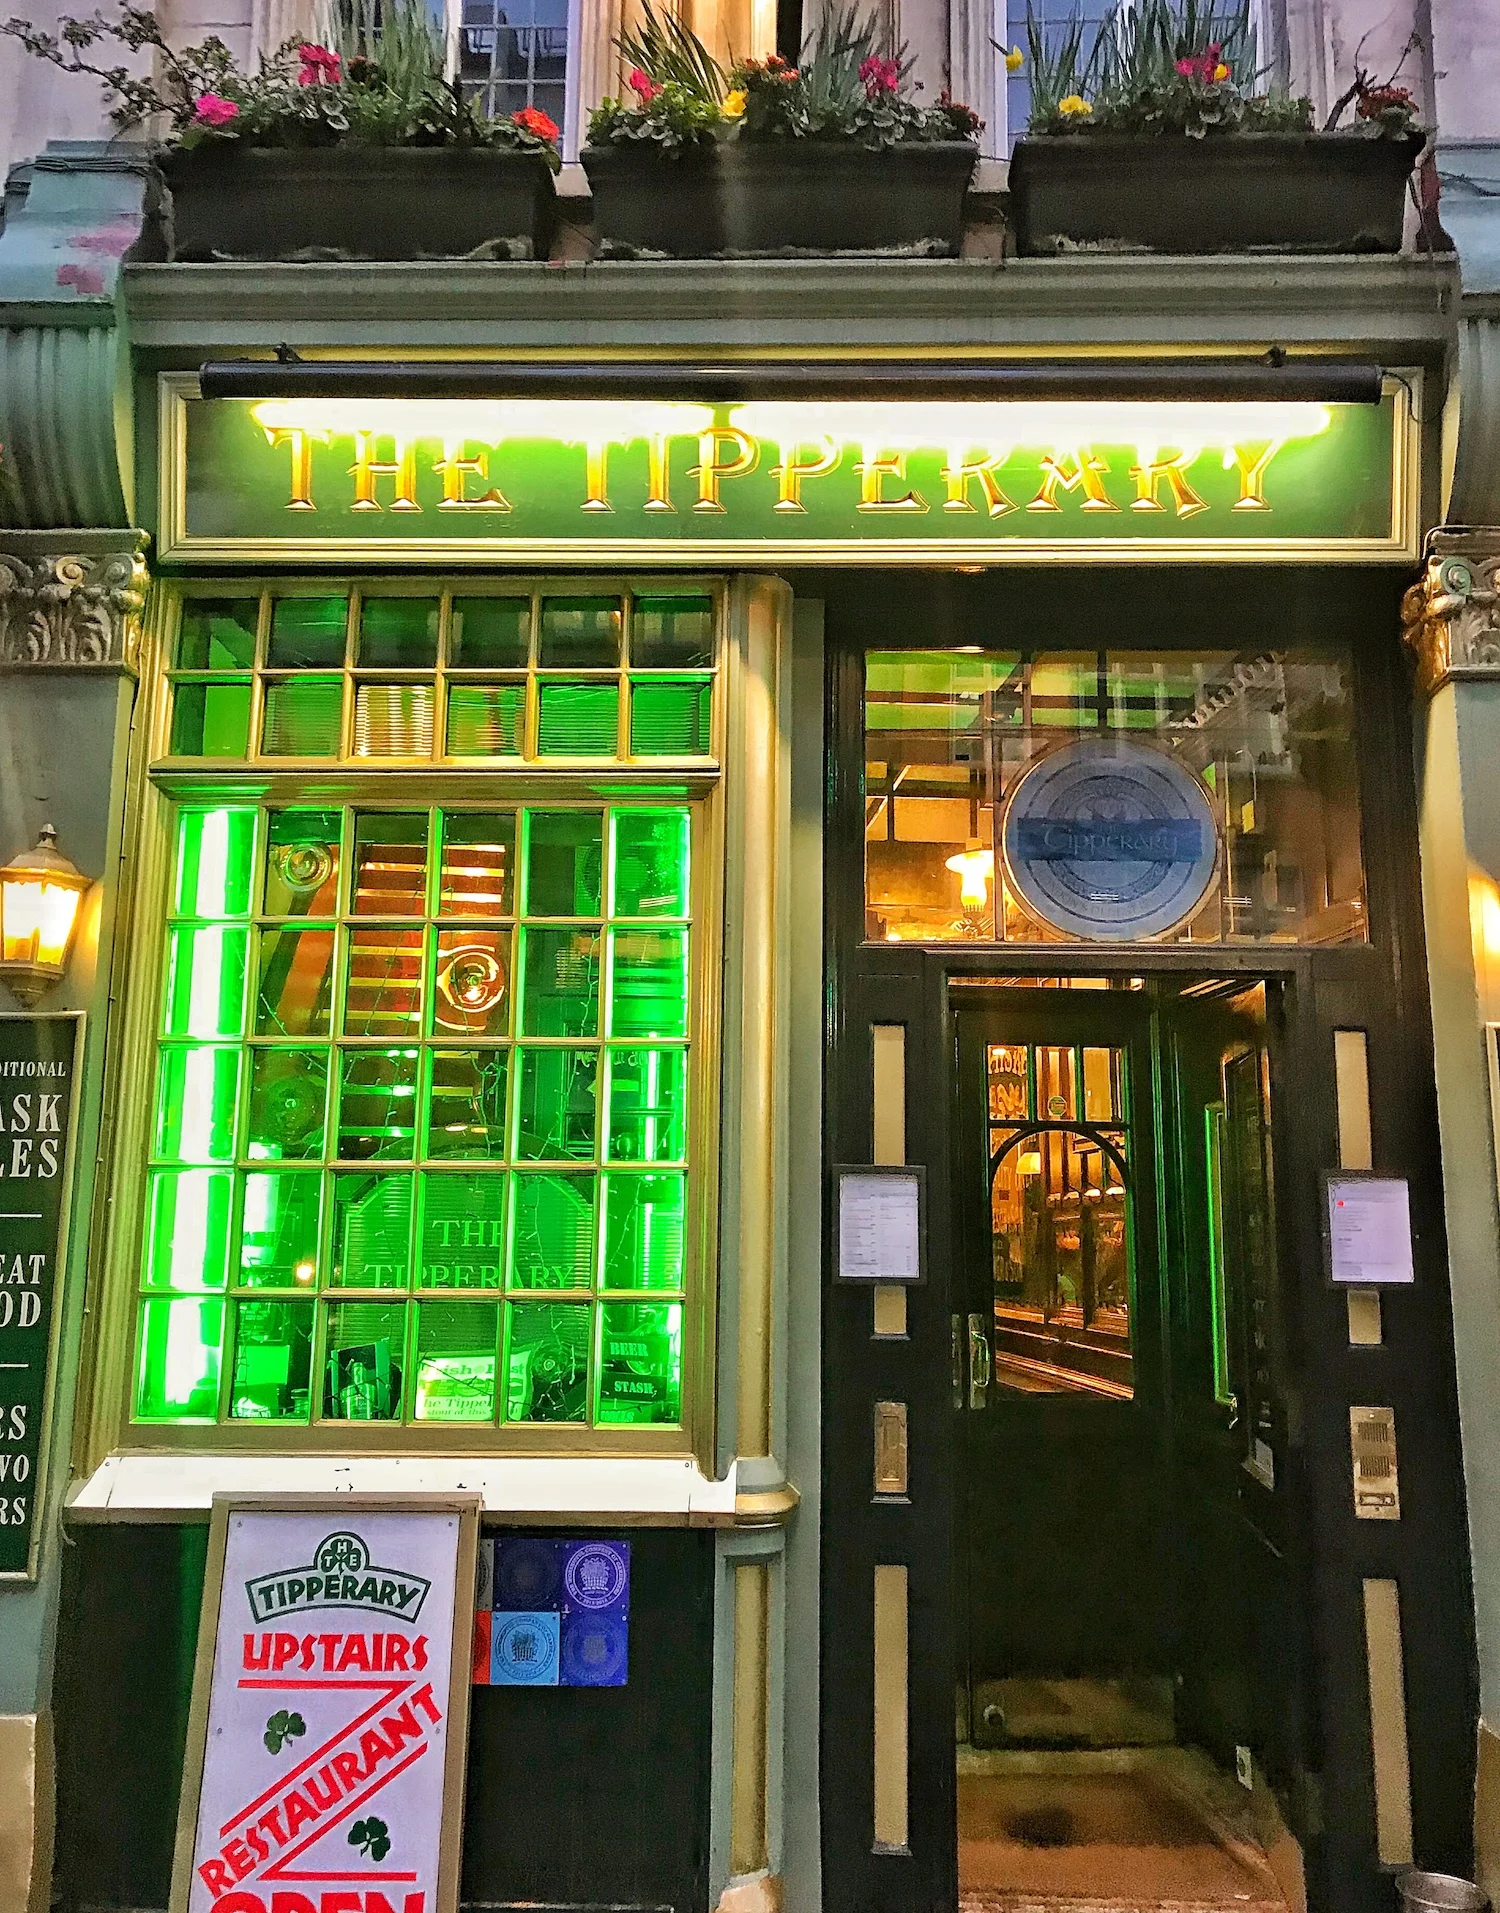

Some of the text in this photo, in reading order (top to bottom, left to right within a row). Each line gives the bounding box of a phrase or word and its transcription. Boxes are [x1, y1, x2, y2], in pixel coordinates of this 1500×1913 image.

[263, 427, 1288, 520] THE TIPPERARY
[0, 1061, 66, 1077] ITIONAL
[0, 1094, 62, 1133] SK
[0, 1138, 58, 1178] ES
[363, 1264, 574, 1289] TIPERRY
[609, 1342, 648, 1357] BEER
[614, 1380, 655, 1394] STASH
[258, 1574, 421, 1612] TIPPERARY
[242, 1632, 429, 1673] UPSTAIRS
[197, 1682, 443, 1897] RESTAURANT
